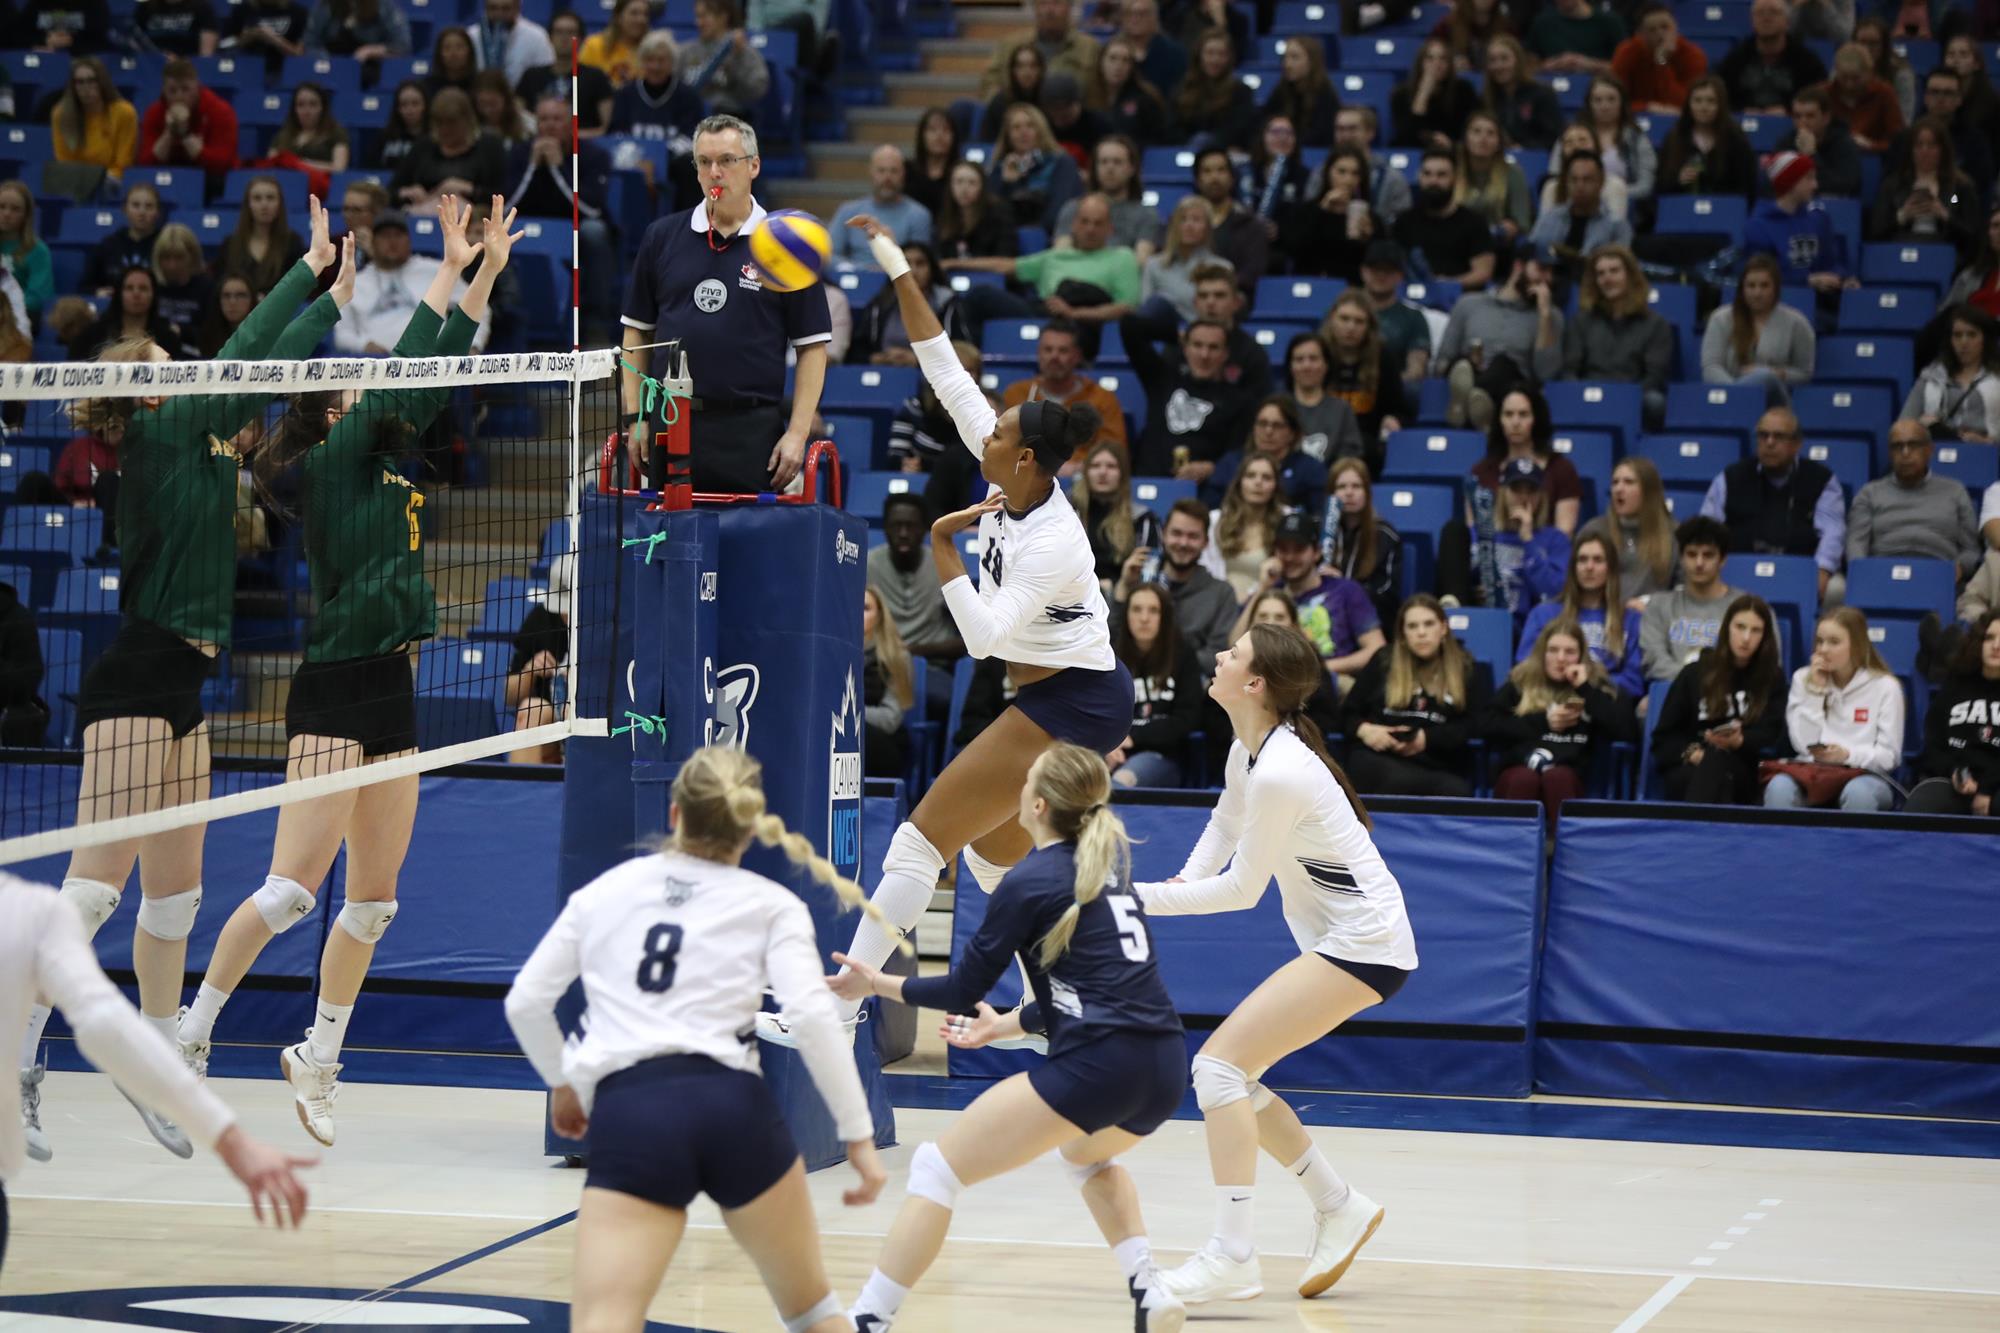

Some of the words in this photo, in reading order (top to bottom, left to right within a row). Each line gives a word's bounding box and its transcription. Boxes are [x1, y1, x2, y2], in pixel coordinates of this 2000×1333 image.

[701, 286, 722, 297] FIVB
[636, 922, 684, 994] 8
[1106, 894, 1150, 962] 5
